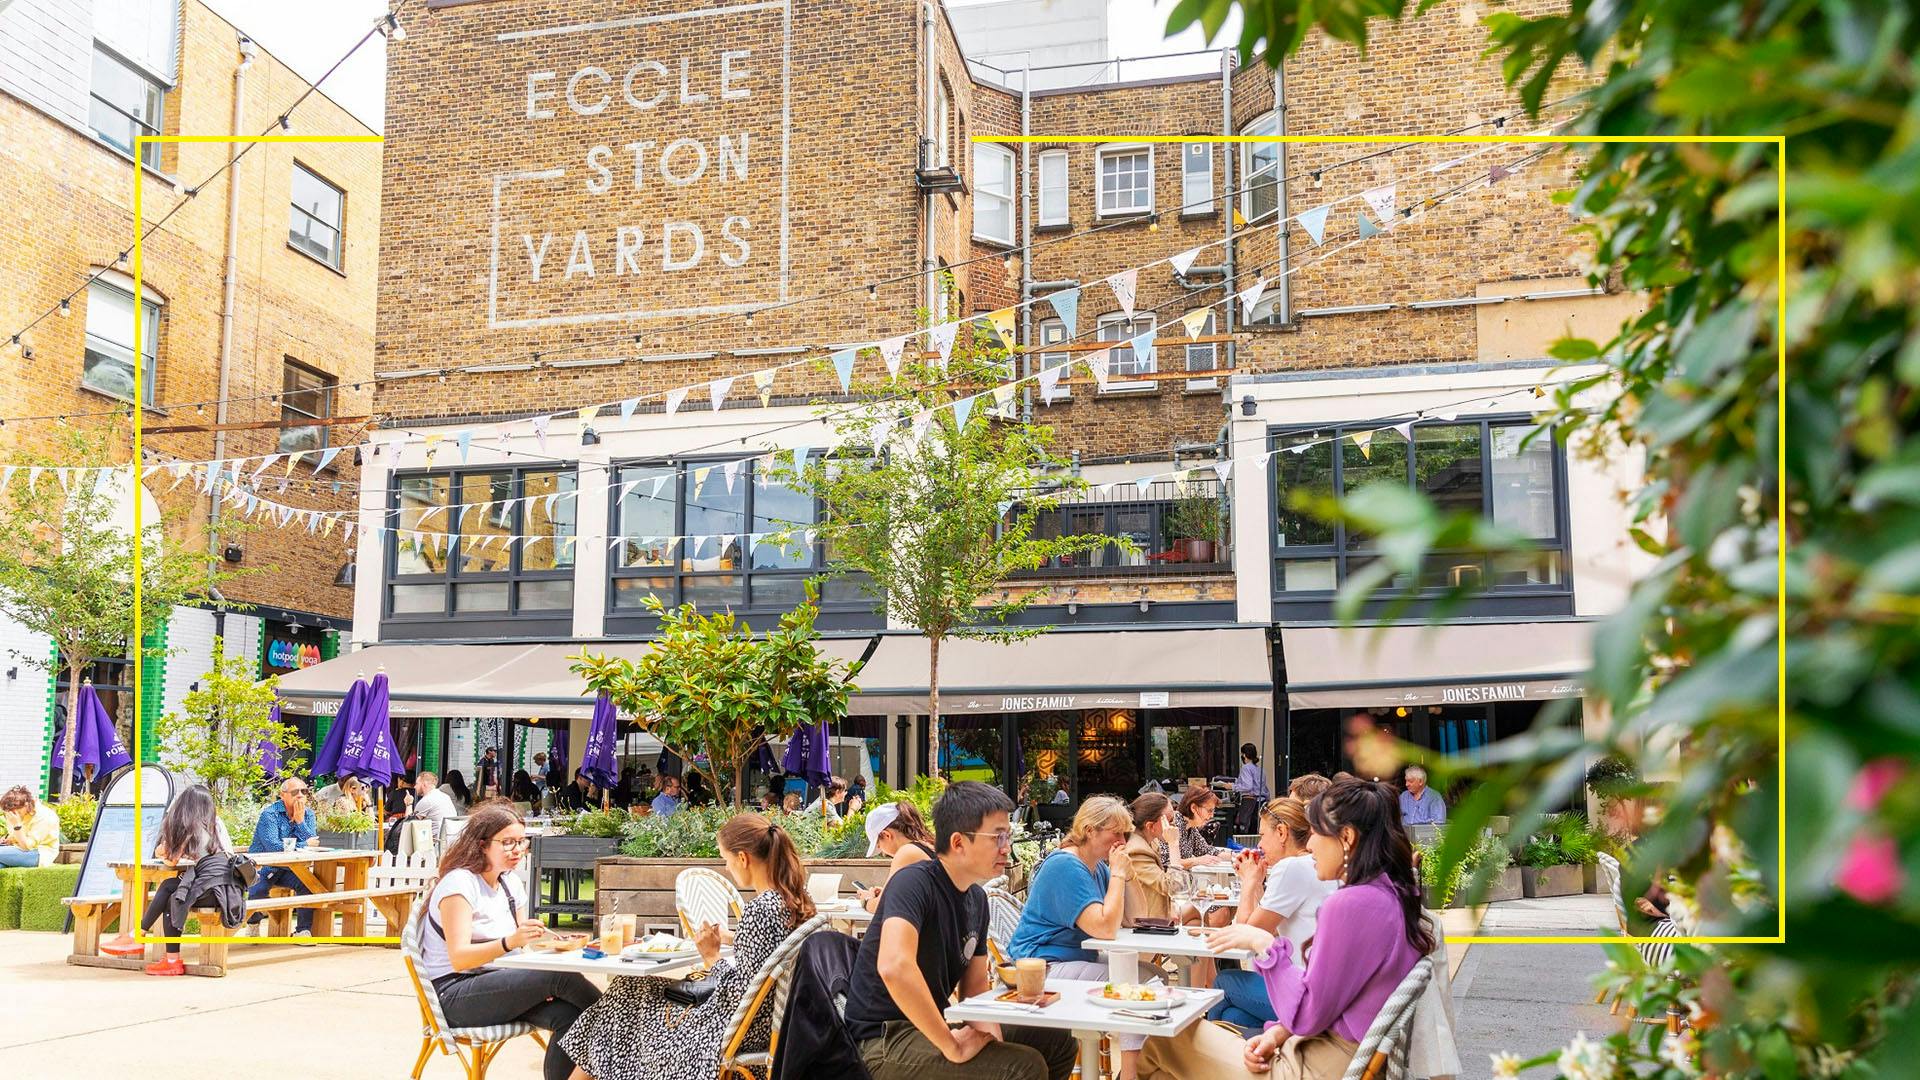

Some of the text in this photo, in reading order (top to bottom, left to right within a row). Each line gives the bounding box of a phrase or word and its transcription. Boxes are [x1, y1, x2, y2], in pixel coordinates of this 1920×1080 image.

[526, 50, 751, 119] ECCLE
[585, 132, 750, 194] STON
[522, 215, 751, 283] YARDS
[272, 650, 318, 666] hotpod yoga
[1404, 692, 1419, 701] the
[1442, 687, 1480, 702] JONES
[1482, 685, 1526, 700] FAMILY
[311, 701, 338, 714] JONES
[967, 696, 1125, 711] the JONES FAMILY kitchen
